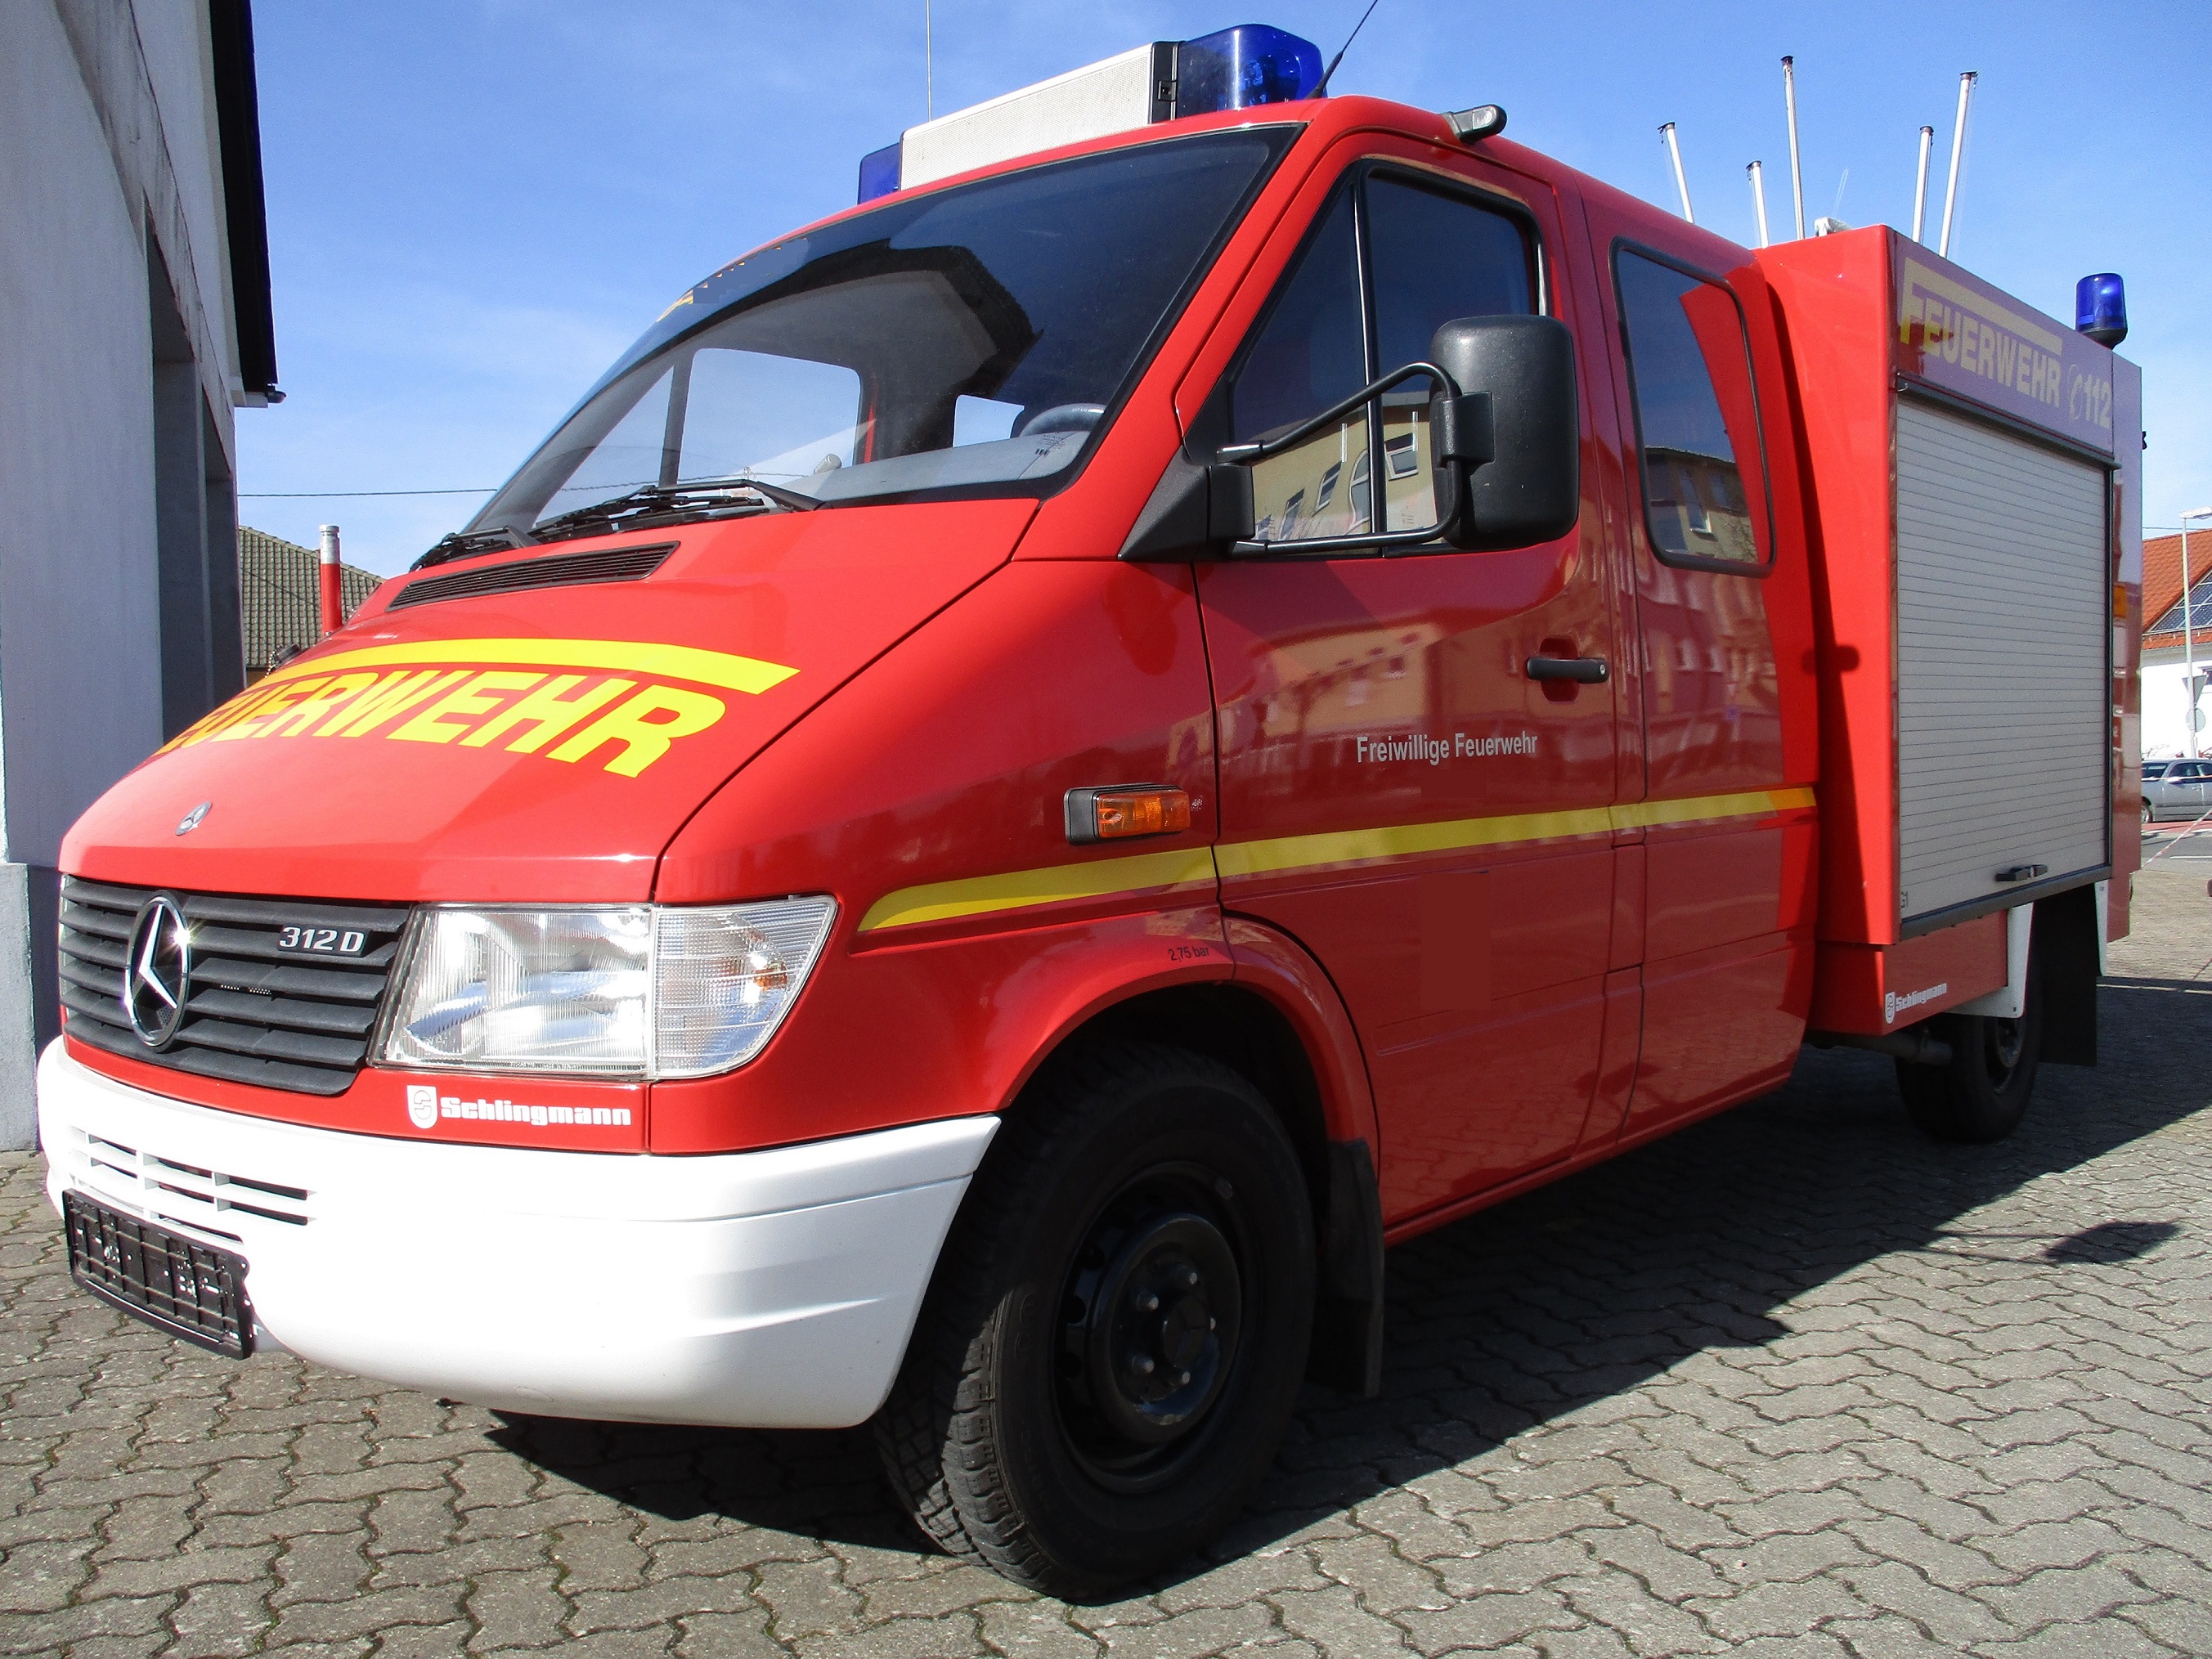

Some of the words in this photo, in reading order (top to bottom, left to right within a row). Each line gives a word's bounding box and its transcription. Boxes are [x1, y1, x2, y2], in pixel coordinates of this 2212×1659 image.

[1899, 257, 2062, 408] FEUERWEHR
[2084, 374, 2111, 430] 112
[153, 667, 727, 778] EUERWEHR
[1356, 735, 1450, 766] Freiwillige
[1455, 730, 1538, 758] Feuerwehr
[280, 926, 338, 951] 312
[339, 931, 365, 953] D
[1168, 946, 1192, 962] 2,75
[1193, 945, 1210, 958] bar
[1896, 982, 1947, 1012] Schlingmann
[440, 1096, 631, 1126] Schlingmann
